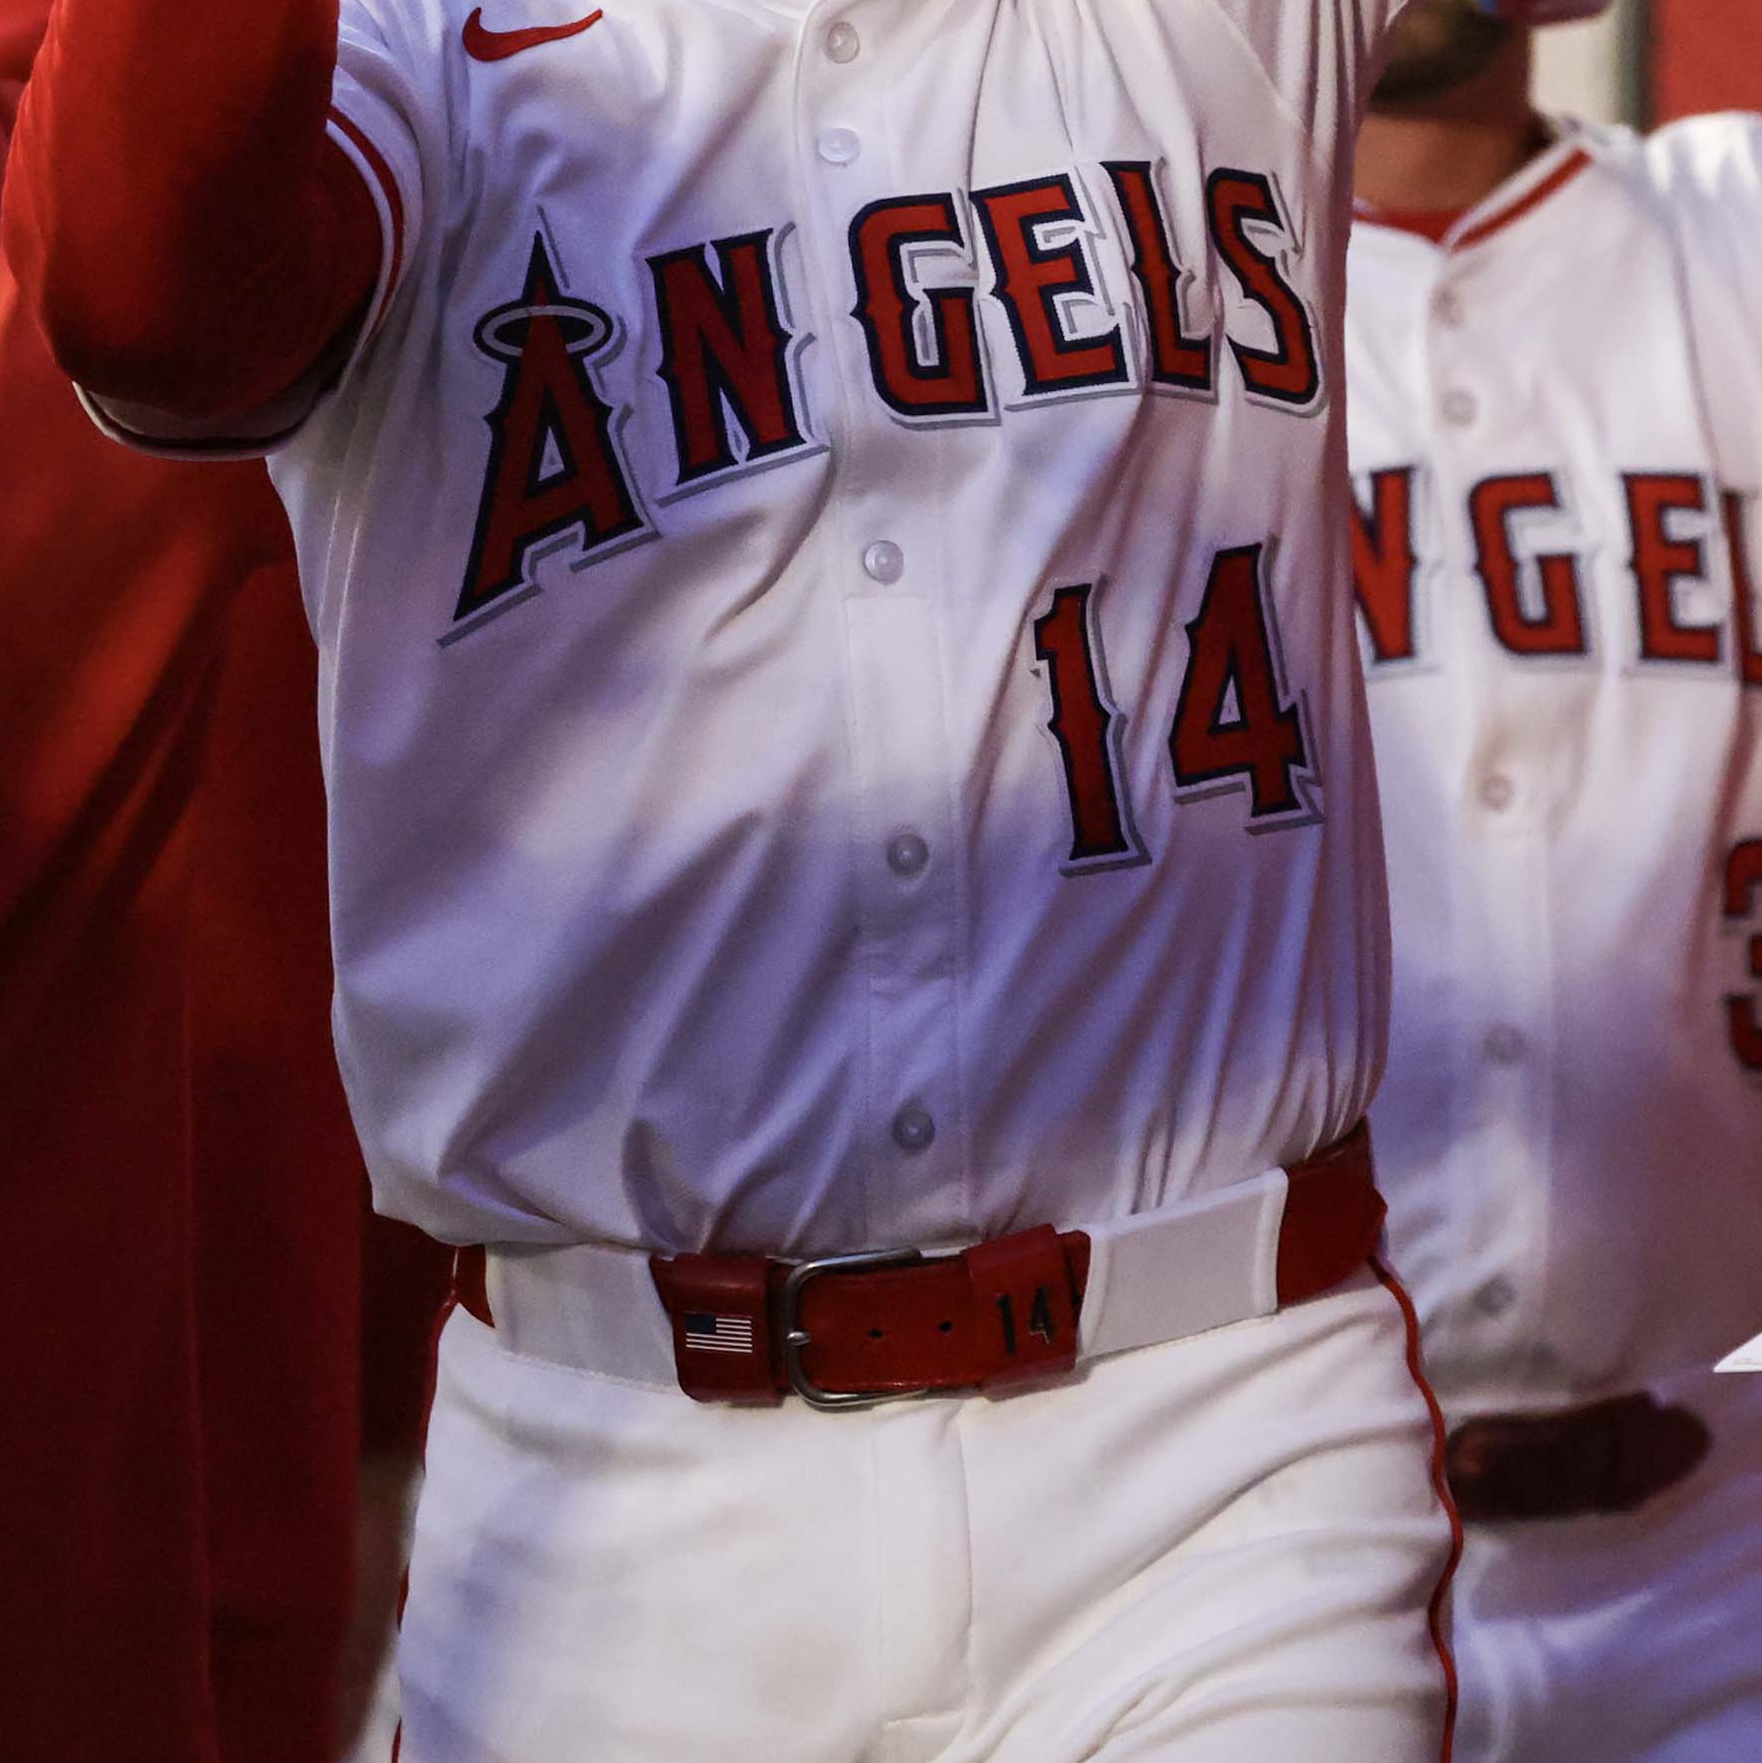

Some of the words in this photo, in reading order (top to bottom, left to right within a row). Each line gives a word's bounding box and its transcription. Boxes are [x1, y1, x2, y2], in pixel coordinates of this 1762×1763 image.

[438, 160, 1330, 647] ANGELS
[1031, 537, 1324, 875] 14
[995, 1284, 1054, 1355] 14
